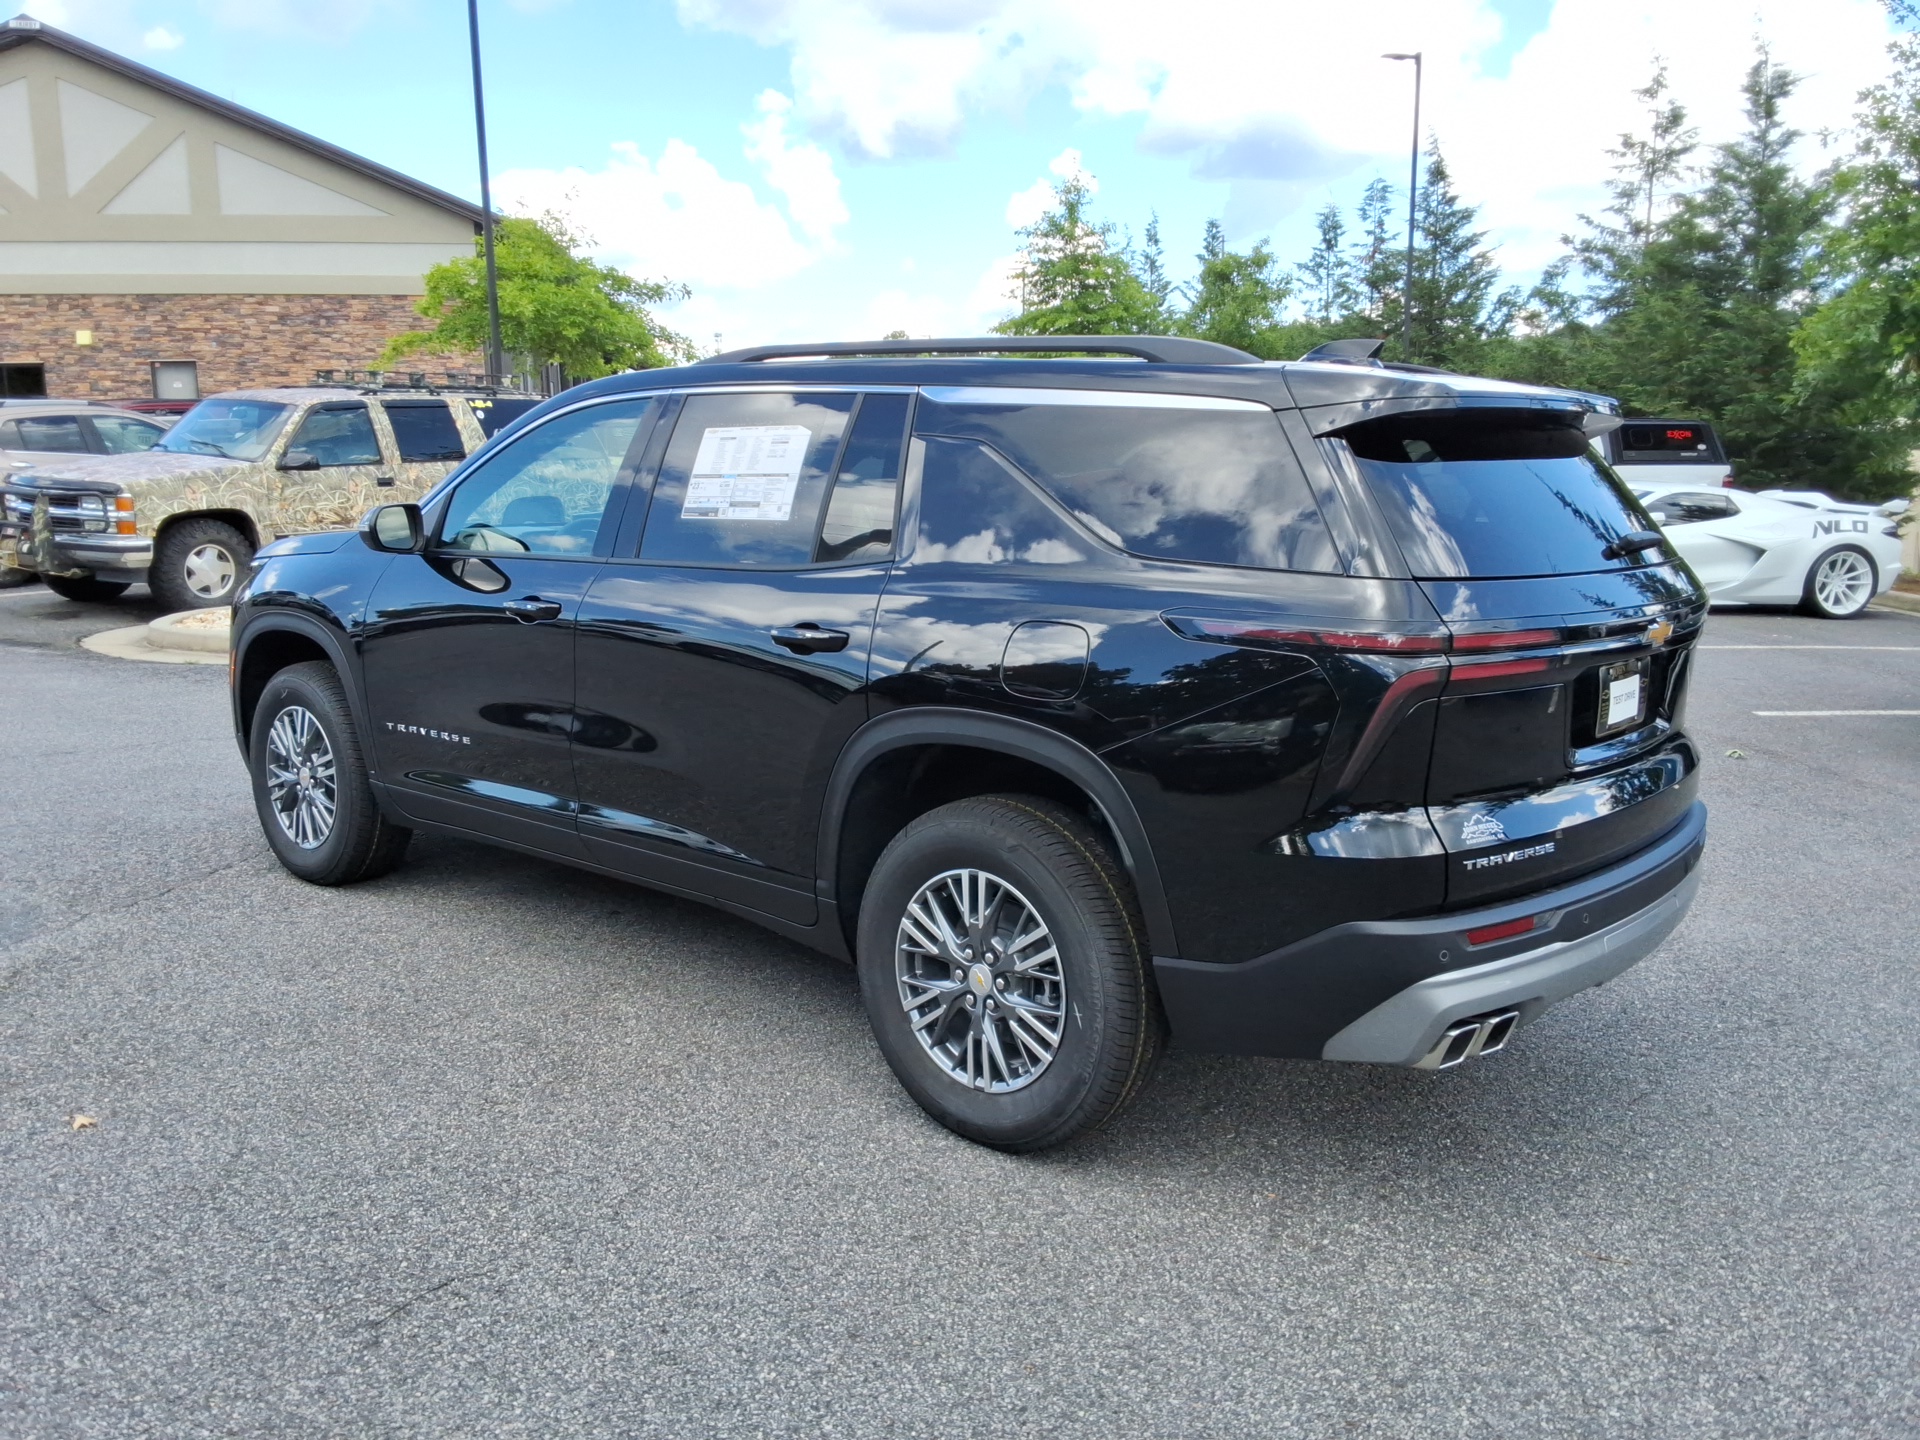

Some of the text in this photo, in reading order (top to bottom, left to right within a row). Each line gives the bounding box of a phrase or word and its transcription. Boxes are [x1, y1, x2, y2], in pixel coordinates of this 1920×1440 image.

[1812, 520, 1868, 539] NLO
[1613, 689, 1636, 705] TEST DRIVE
[386, 722, 471, 745] TRAVERSE
[1463, 842, 1556, 870] TRAVERSE
